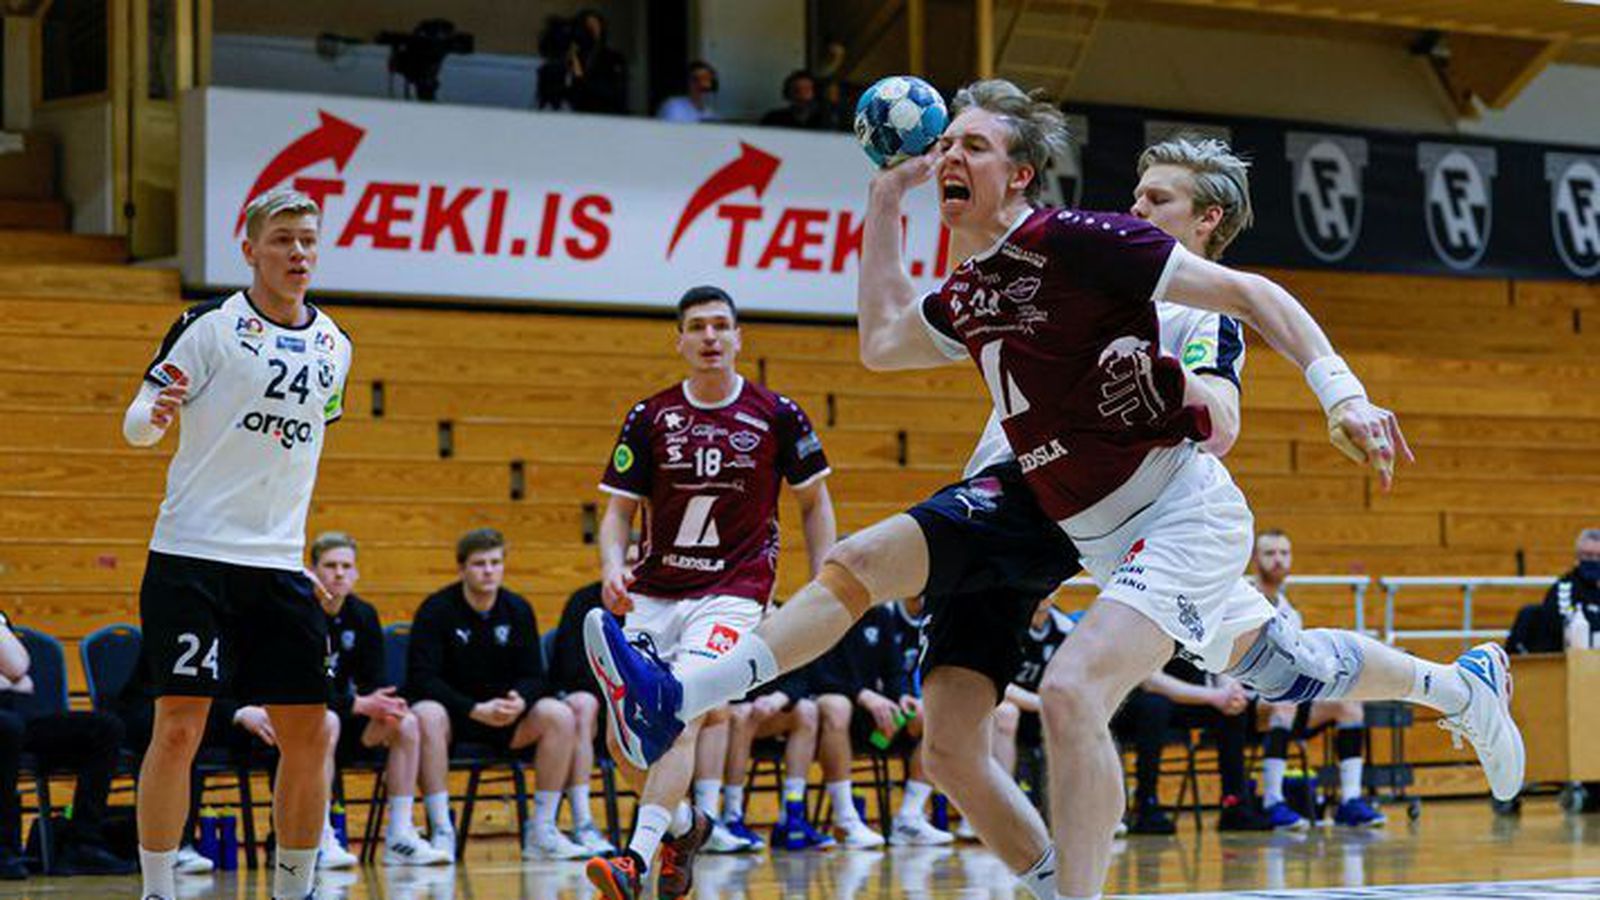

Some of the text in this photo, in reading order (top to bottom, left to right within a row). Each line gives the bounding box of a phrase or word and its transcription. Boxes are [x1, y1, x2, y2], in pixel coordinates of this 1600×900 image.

[294, 177, 613, 261] TÆKI.IS
[264, 358, 310, 405] 24
[242, 411, 312, 449] origo
[695, 446, 723, 477] 18
[172, 632, 219, 680] 24
